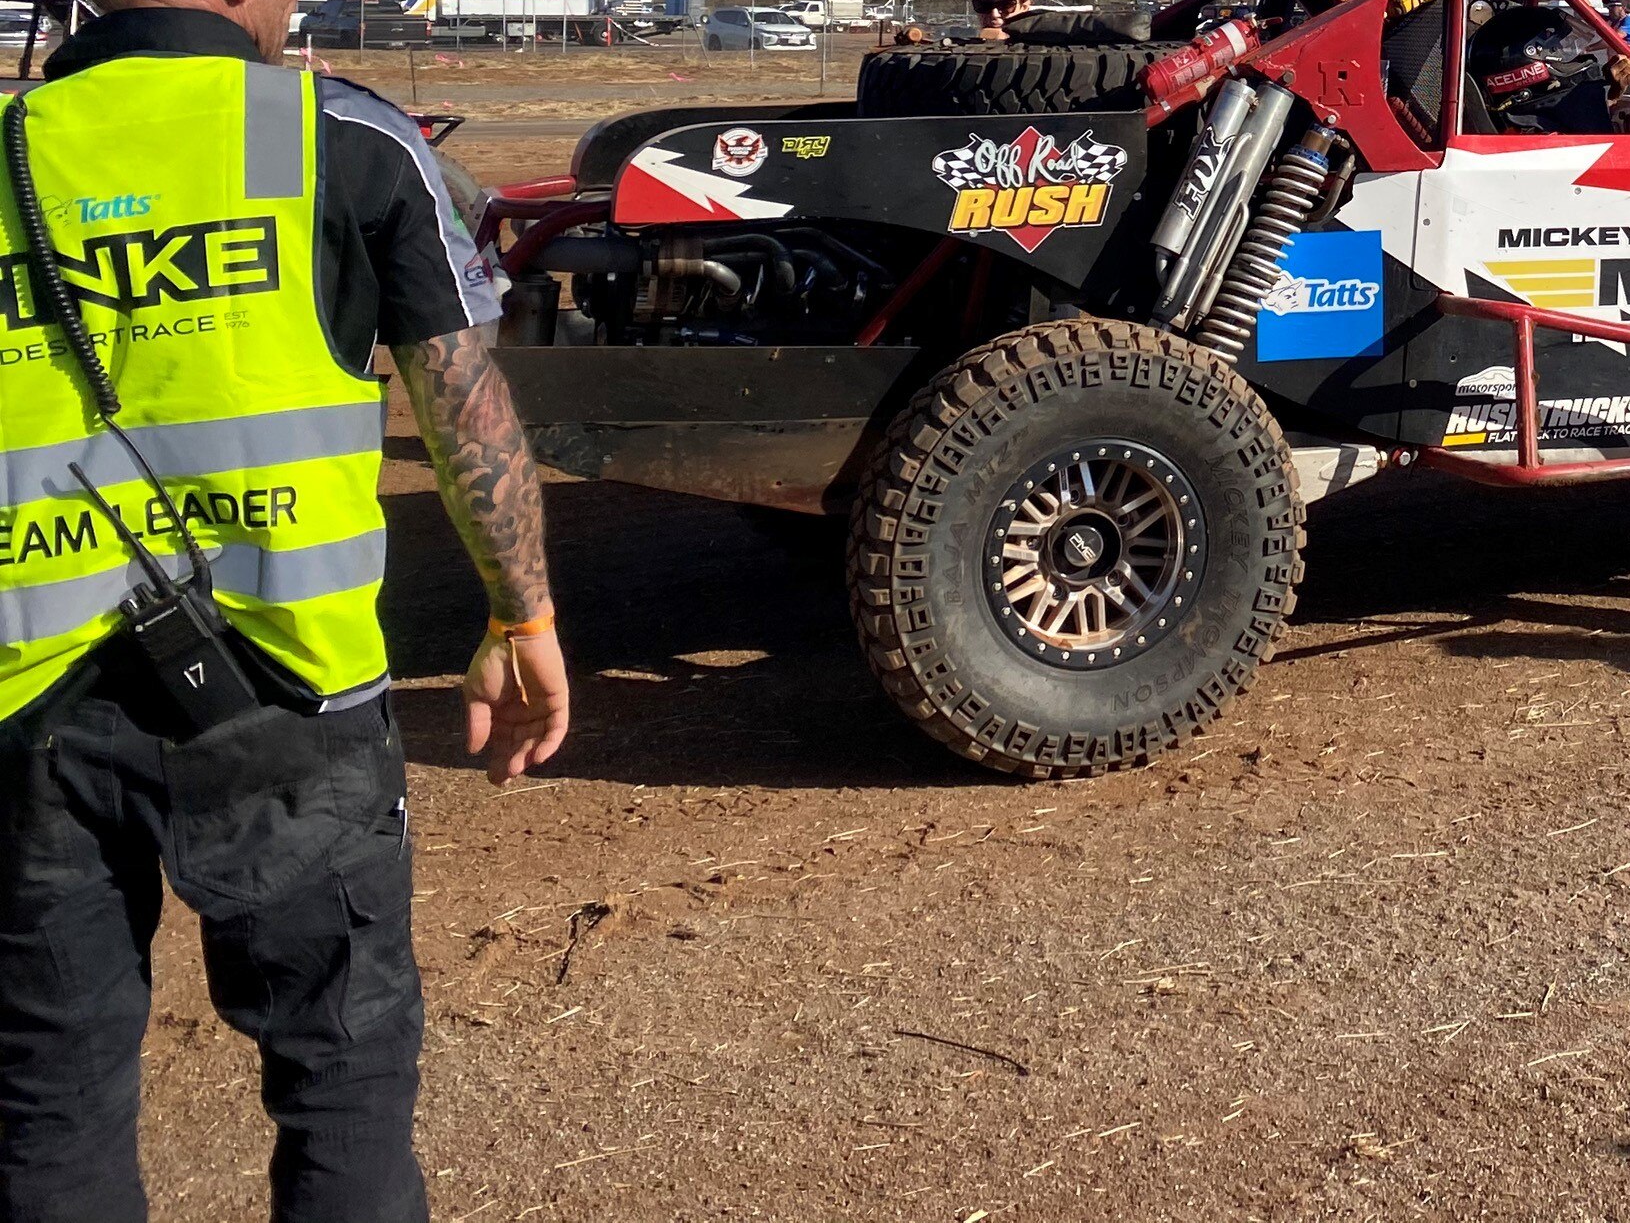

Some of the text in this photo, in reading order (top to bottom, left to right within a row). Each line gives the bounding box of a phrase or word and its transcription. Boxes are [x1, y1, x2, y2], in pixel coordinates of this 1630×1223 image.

[1486, 62, 1545, 87] ACELINE
[974, 134, 1083, 188] Off Road
[1174, 124, 1236, 222] FOX
[74, 193, 152, 224] Tatts
[951, 183, 1109, 229] RUSH
[0, 221, 274, 327] INKE
[1305, 283, 1373, 308] Tatts
[223, 310, 249, 321] EST
[0, 315, 216, 365] DESRT RACE
[1553, 427, 1569, 439] TO
[1570, 426, 1601, 438] RACE
[0, 510, 99, 565] EAM
[1111, 456, 1251, 714] MICKEY THOMPSON
